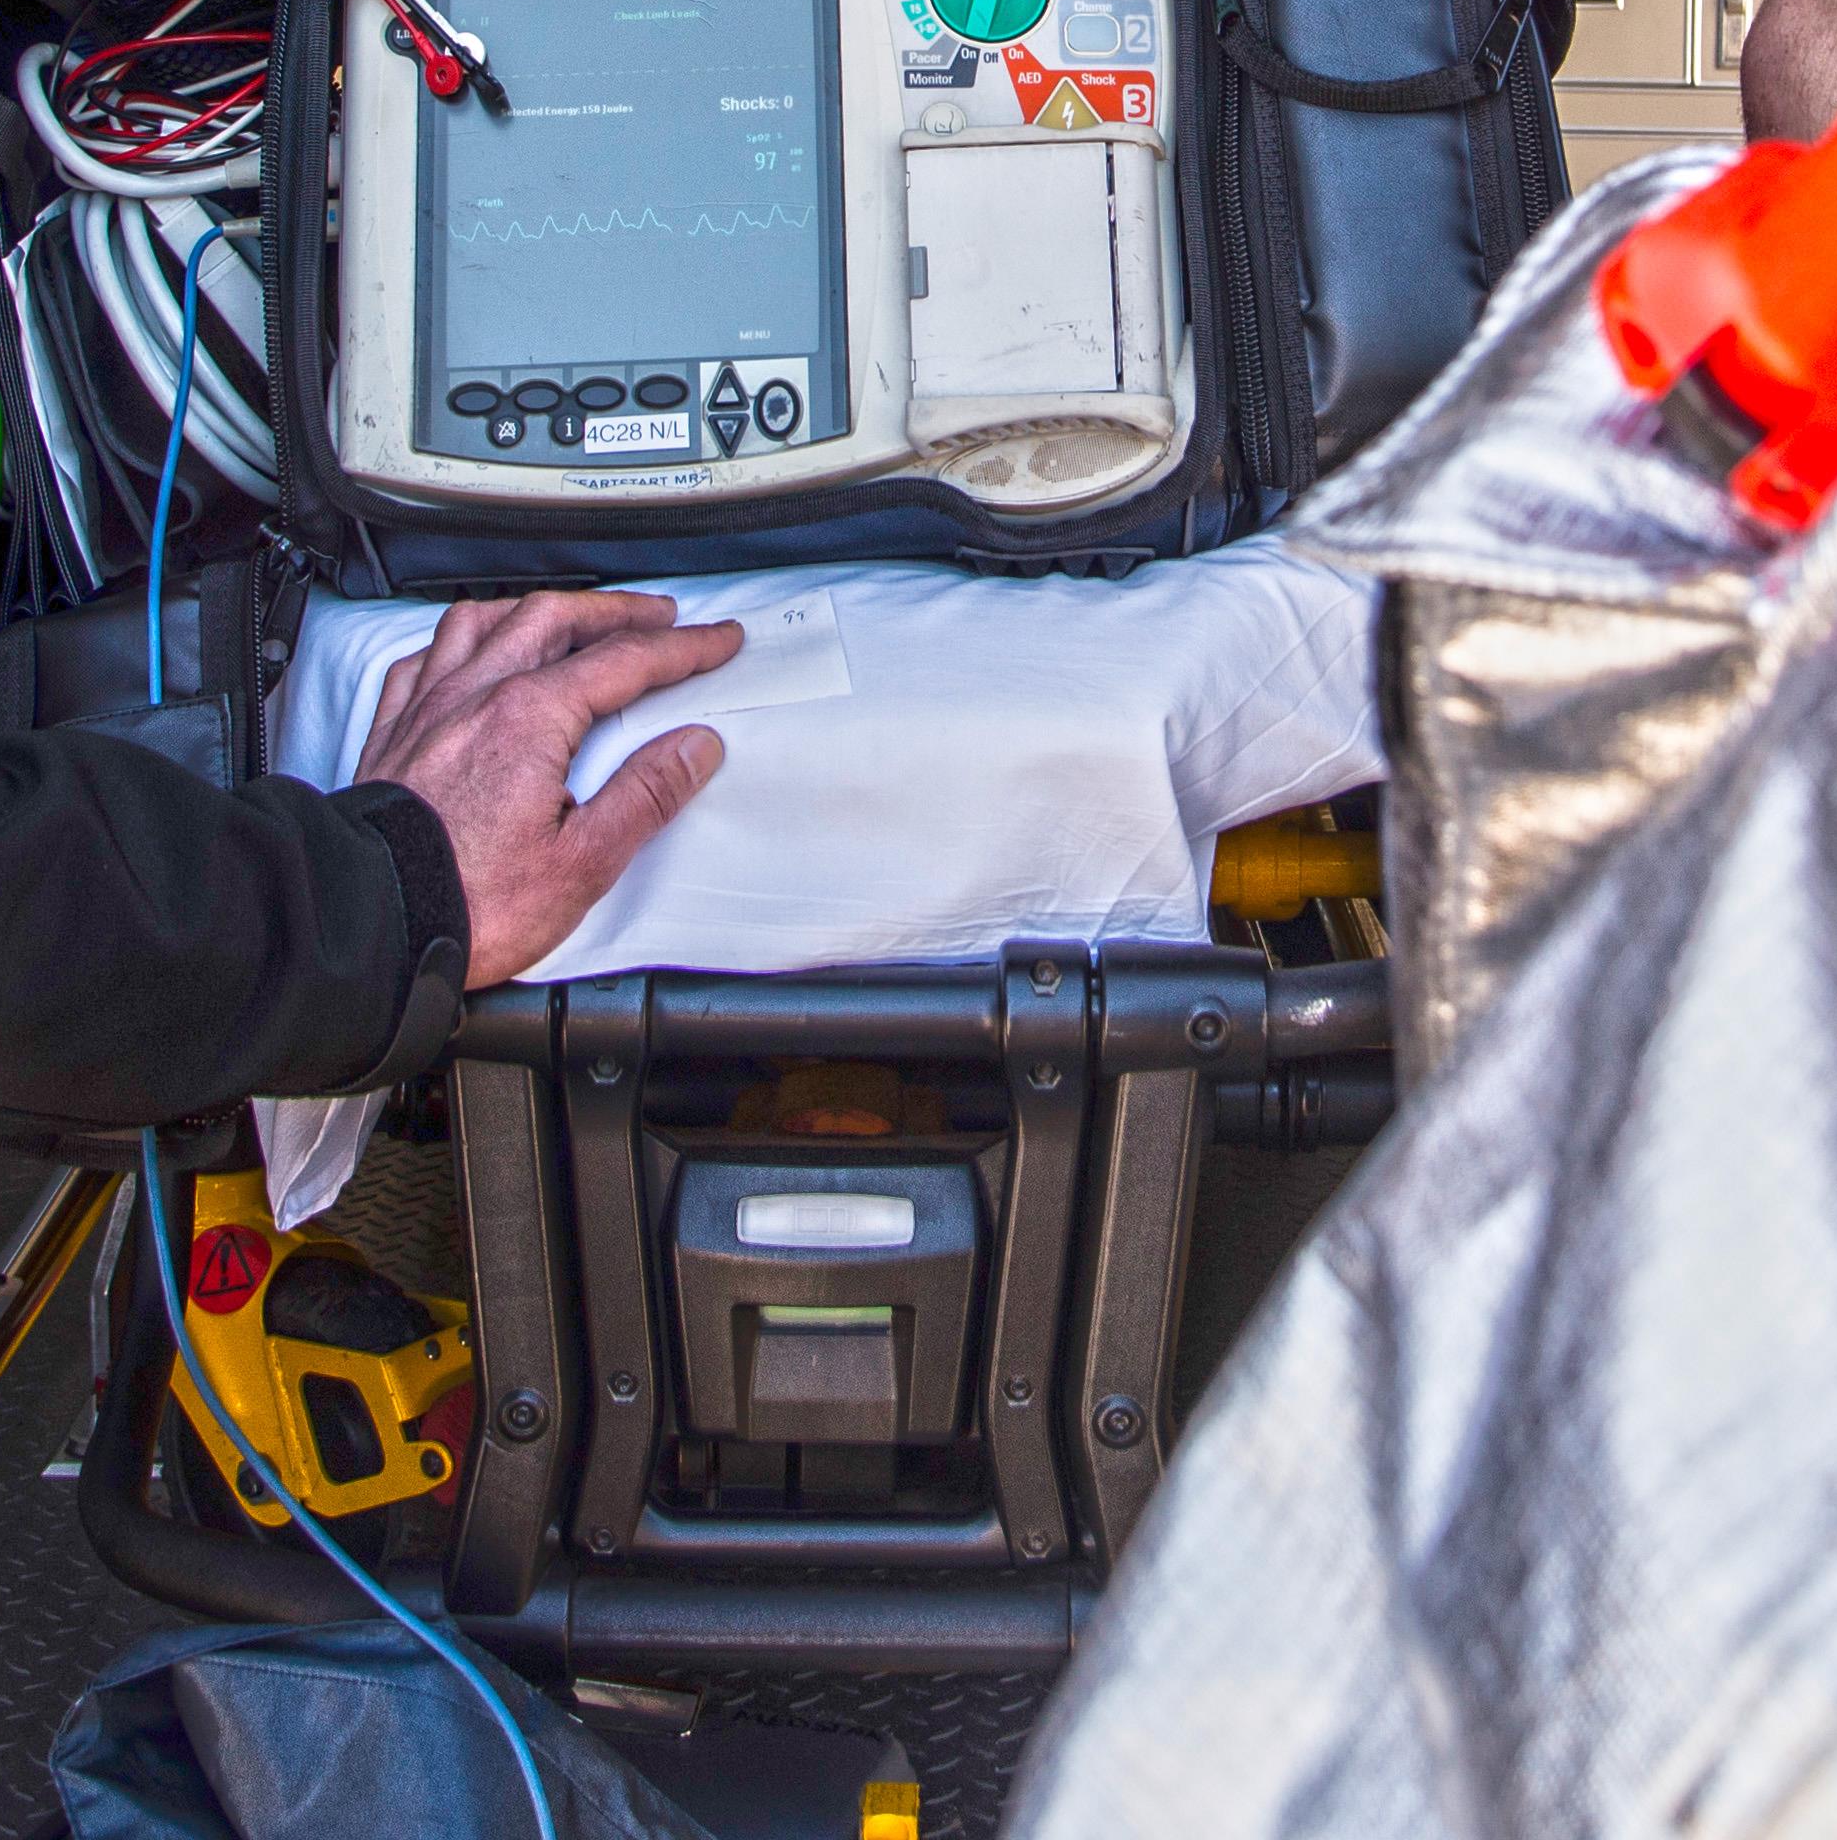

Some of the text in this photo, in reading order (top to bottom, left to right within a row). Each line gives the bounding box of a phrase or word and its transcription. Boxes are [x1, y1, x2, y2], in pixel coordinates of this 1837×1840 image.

[911, 4, 922, 14] 15
[1074, 1, 1112, 14] Charge
[1128, 18, 1148, 48] 2
[909, 52, 942, 64] Pacer
[961, 47, 977, 60] On
[984, 52, 999, 63] Off
[1008, 48, 1024, 60] On
[909, 73, 954, 85] Monitor
[1018, 72, 1042, 84] AED
[1081, 73, 1116, 86] Shock
[582, 105, 600, 114] 150
[602, 104, 633, 114] Joules
[720, 95, 794, 111] Shocks: 0
[1127, 89, 1147, 118] 3
[754, 151, 777, 171] 97
[478, 197, 504, 207] Pleth
[739, 329, 771, 340] MENU
[586, 420, 686, 443] 4C28 N/L
[573, 476, 668, 489] EARTSTART
